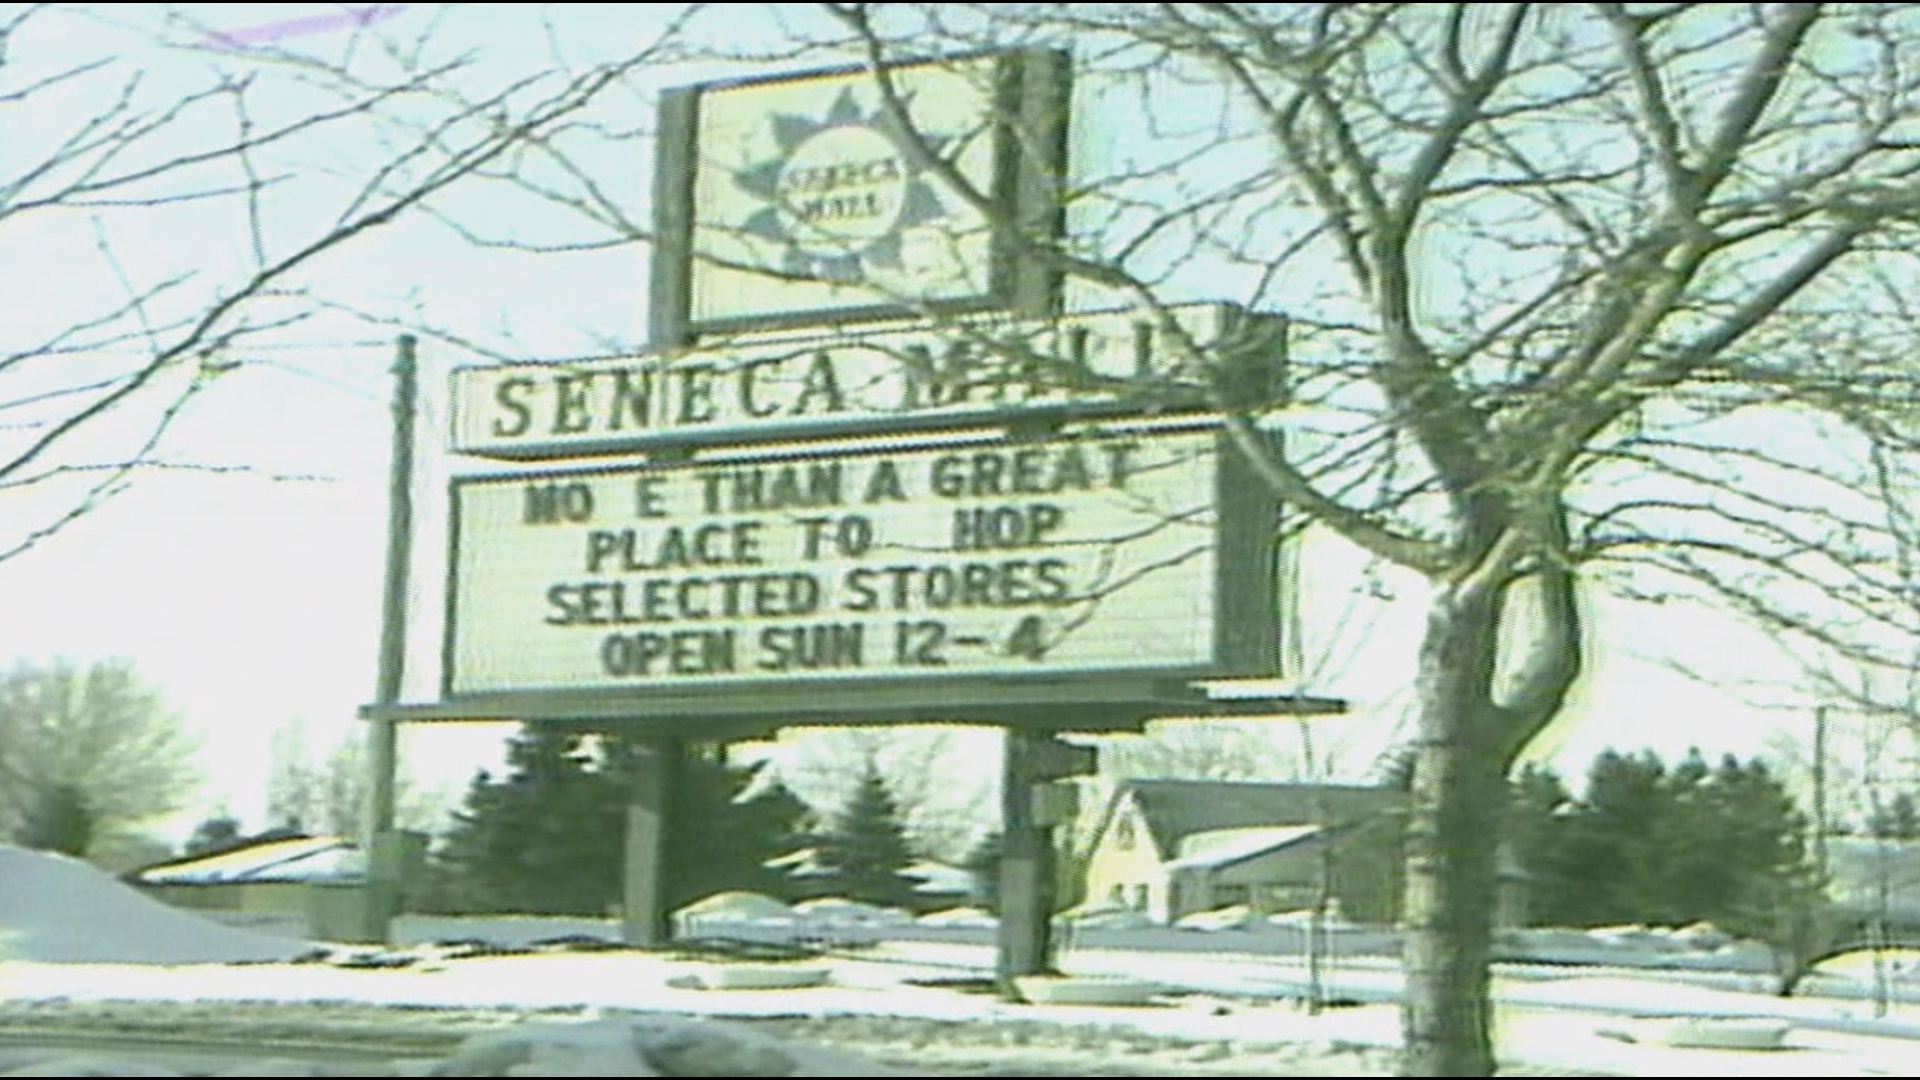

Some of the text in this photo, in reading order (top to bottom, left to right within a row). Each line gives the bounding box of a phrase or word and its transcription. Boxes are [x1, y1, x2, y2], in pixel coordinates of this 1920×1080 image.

[493, 348, 846, 437] SENECA
[697, 461, 843, 515] THAN
[864, 461, 907, 505] A
[929, 443, 1140, 499] GREAT
[585, 503, 1063, 573] PLACE TO HOP
[545, 557, 1069, 626] SELECTED STORES
[600, 628, 736, 677] OPEN
[758, 622, 865, 671] SUN
